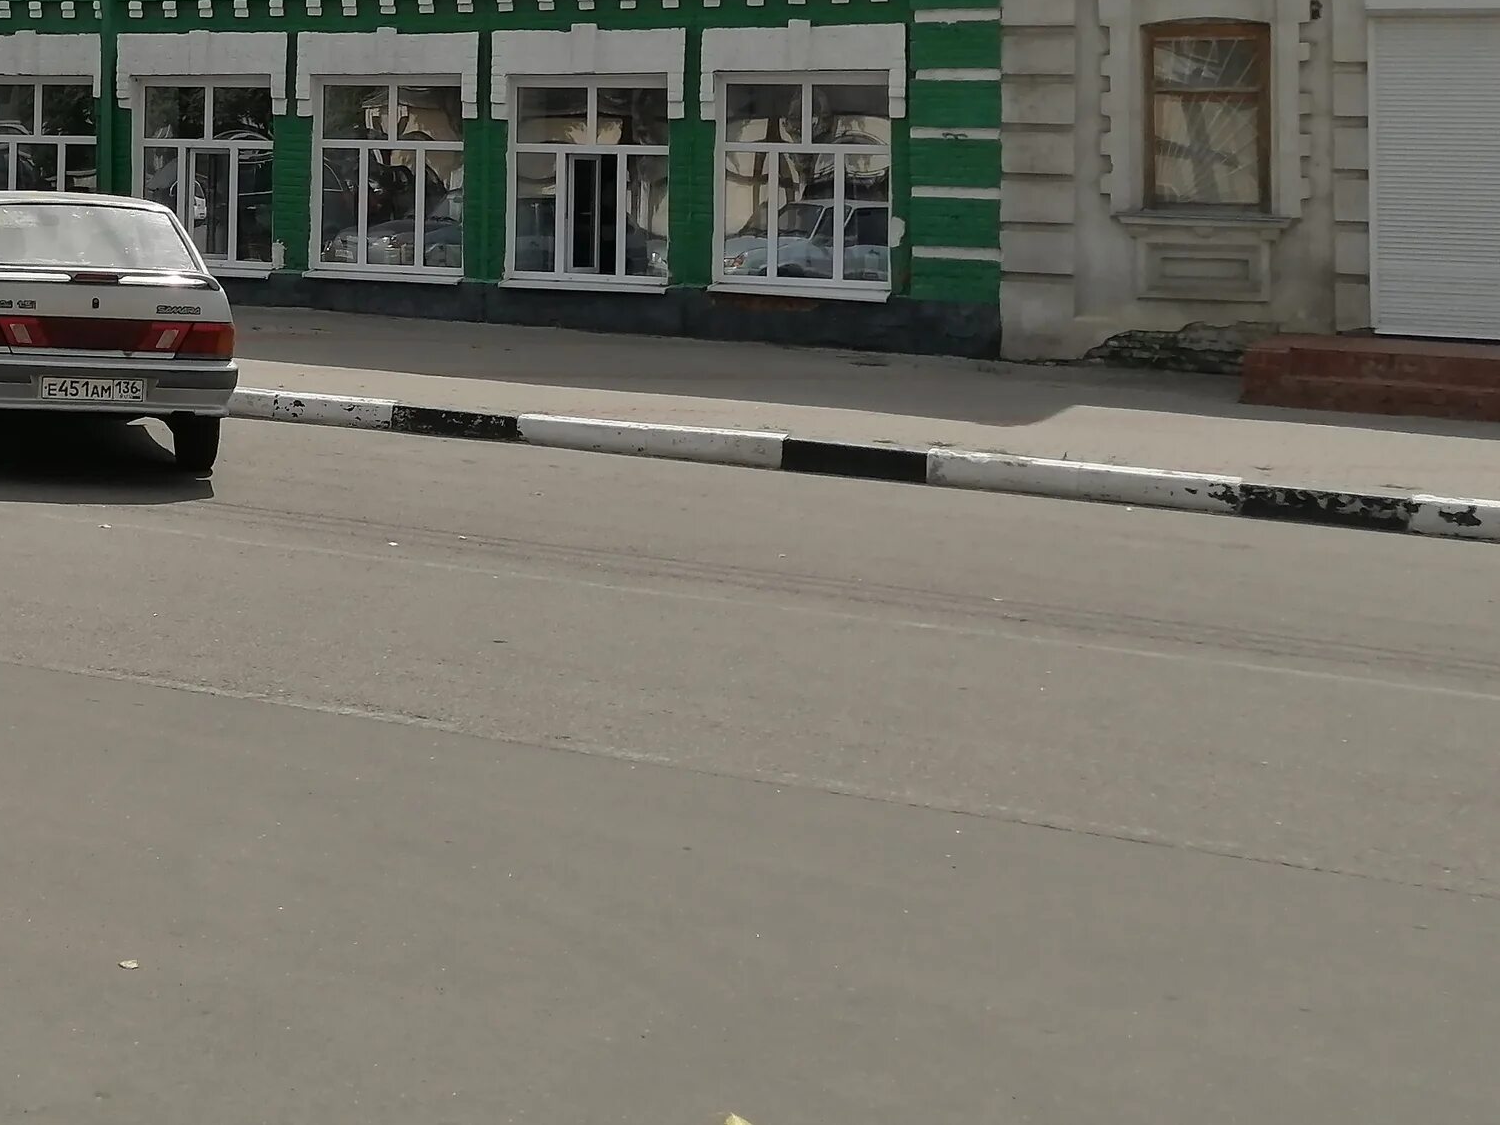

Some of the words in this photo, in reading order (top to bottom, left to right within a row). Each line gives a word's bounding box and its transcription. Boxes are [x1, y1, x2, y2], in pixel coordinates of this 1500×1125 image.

[156, 304, 201, 315] SAMARA
[47, 379, 112, 398] Е451АМ
[115, 381, 140, 394] 136
